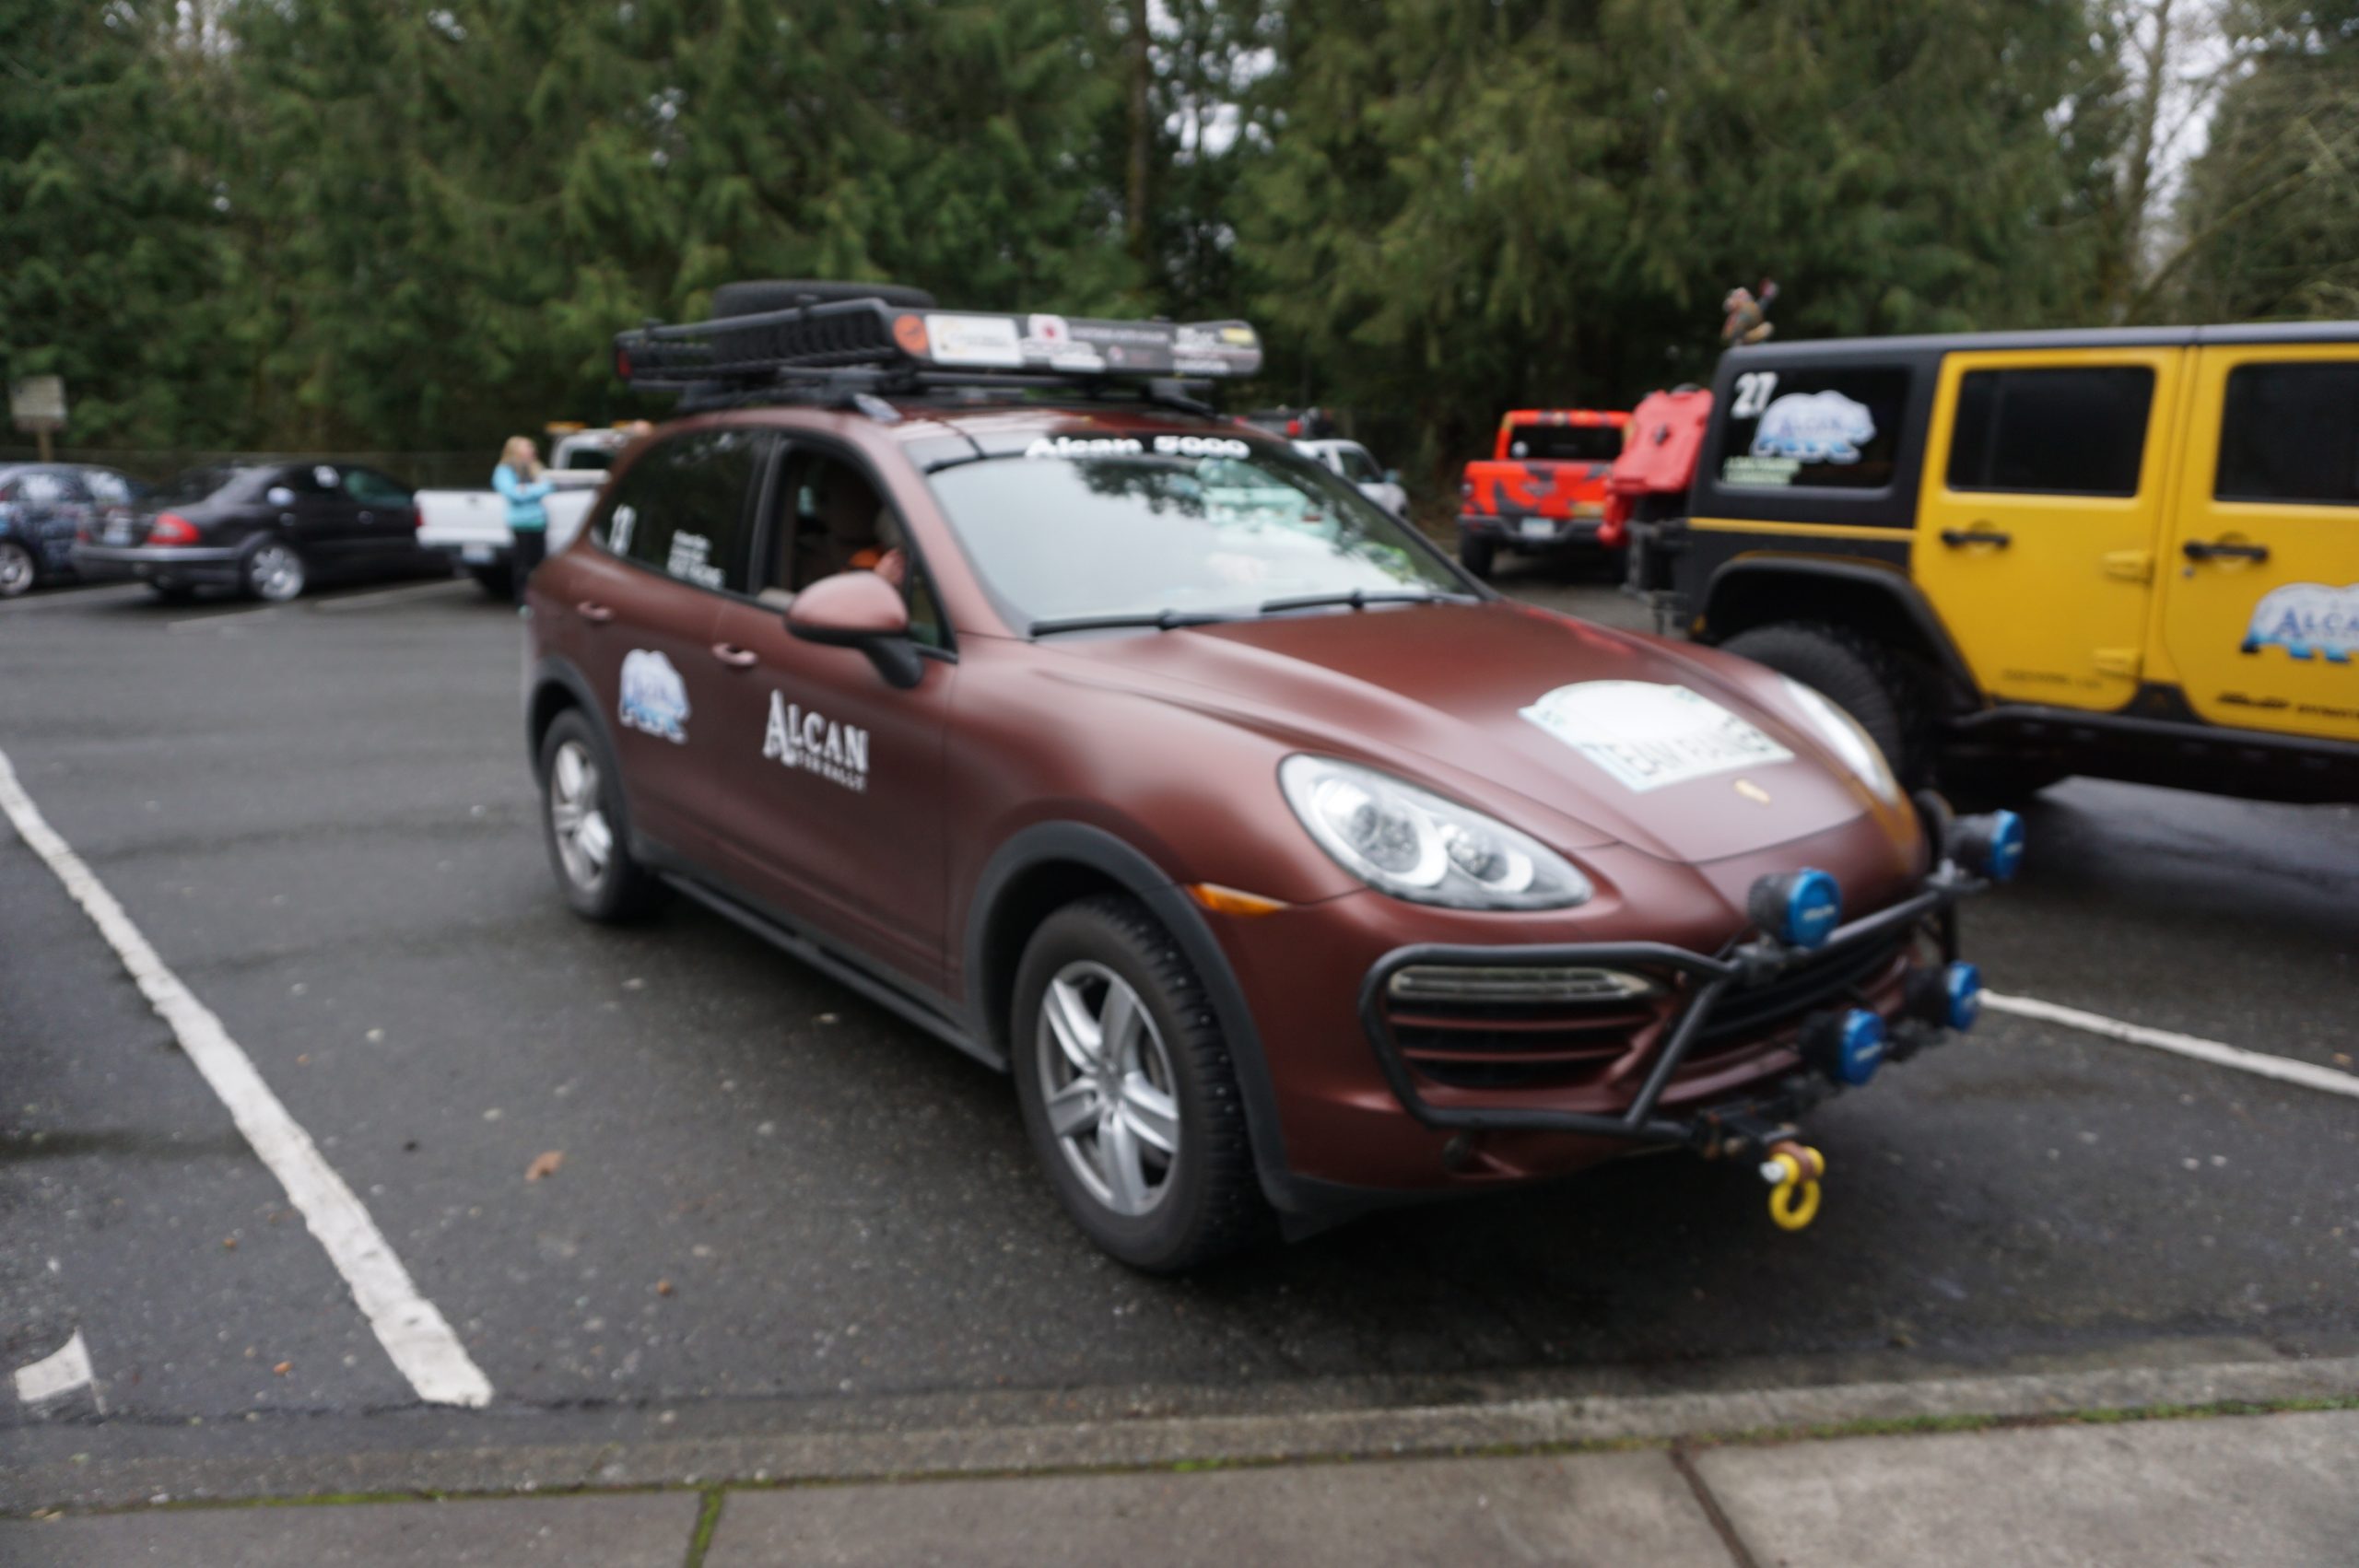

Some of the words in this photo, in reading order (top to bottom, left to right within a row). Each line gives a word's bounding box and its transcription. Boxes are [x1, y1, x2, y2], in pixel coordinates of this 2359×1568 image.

[1025, 436, 1144, 459] Alcan
[1153, 435, 1251, 459] 5000
[762, 687, 869, 774] ALCAN
